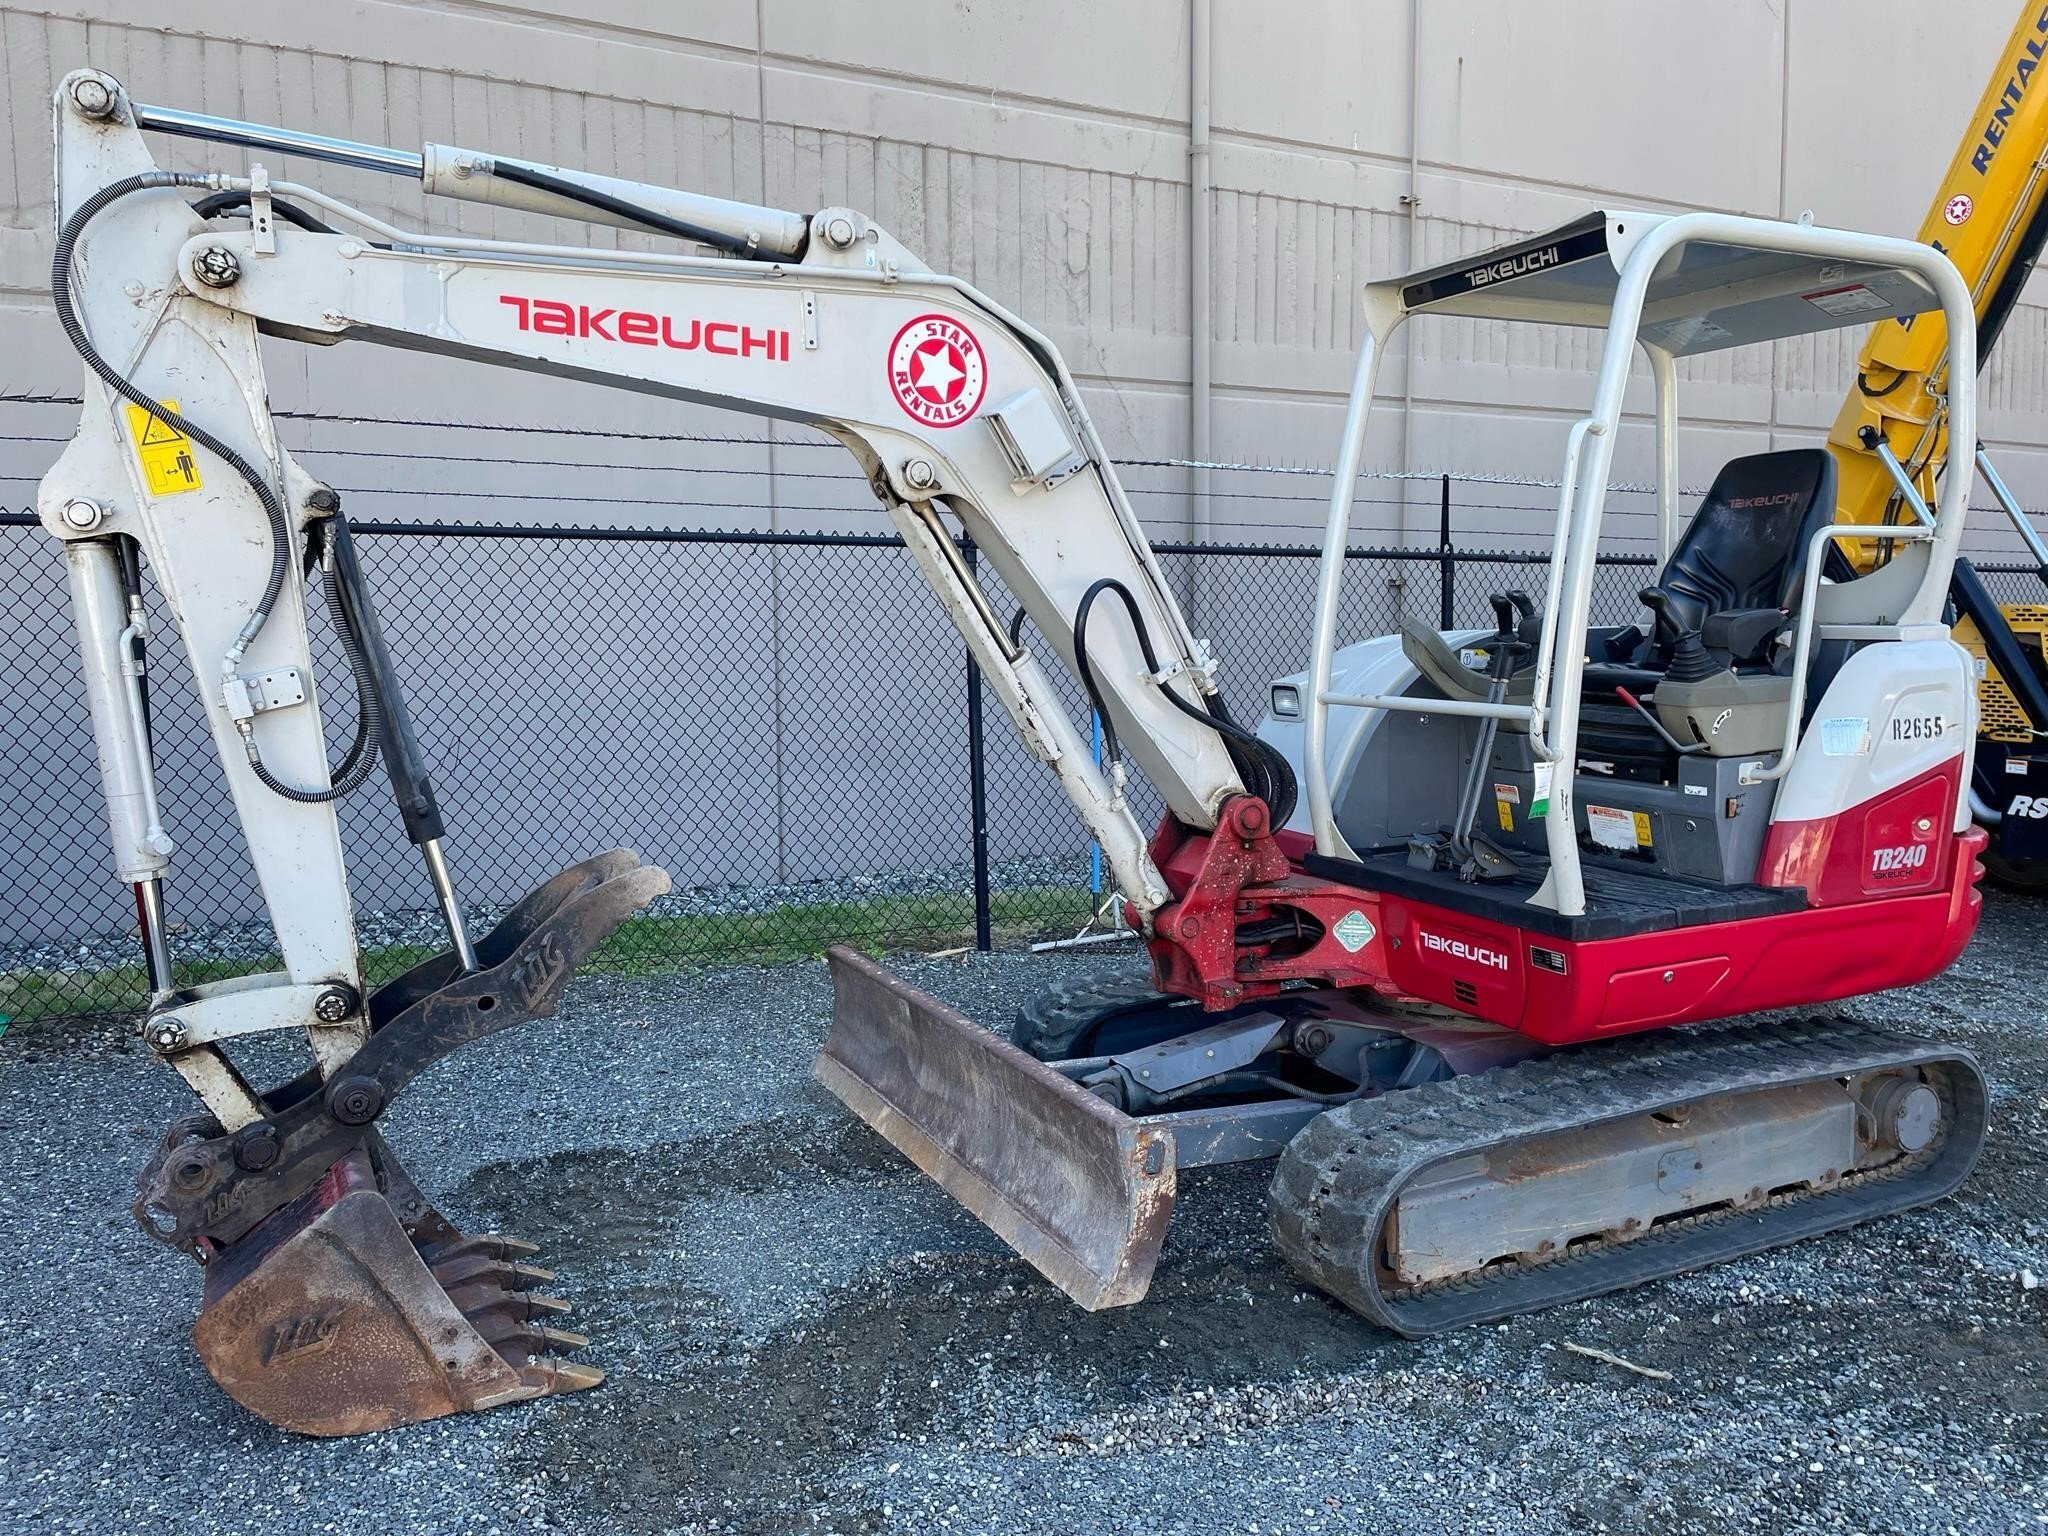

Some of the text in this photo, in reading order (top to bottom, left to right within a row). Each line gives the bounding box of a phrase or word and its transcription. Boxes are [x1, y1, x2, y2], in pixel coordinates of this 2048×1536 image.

[1465, 246, 1560, 287] TAKEUCHI
[499, 294, 790, 362] TAKEUCHI
[925, 322, 974, 358] STAR
[895, 370, 967, 421] RENTALS
[1727, 492, 1799, 509] TAKEUCHI
[1892, 716, 1943, 740] R2655
[1871, 844, 1927, 872] TB240
[1871, 868, 1914, 880] TAKEUCHI
[1419, 930, 1509, 971] TAKEUCHI
